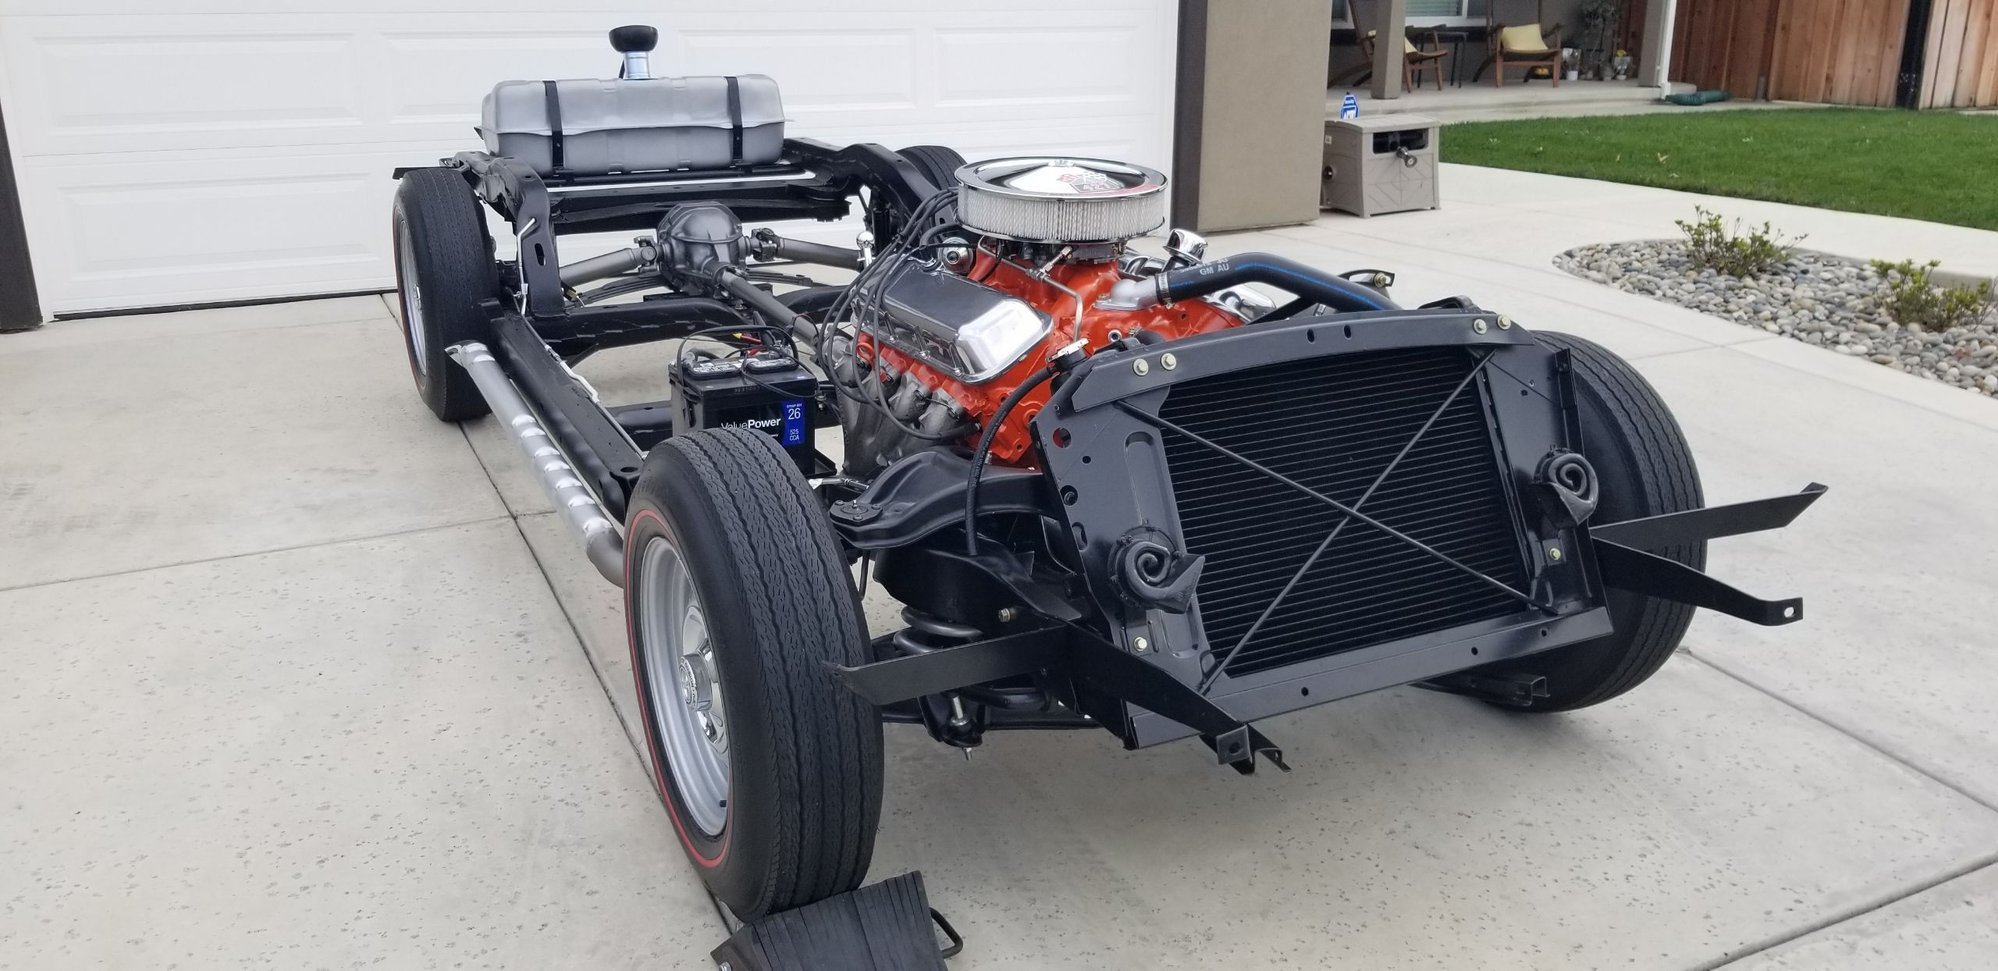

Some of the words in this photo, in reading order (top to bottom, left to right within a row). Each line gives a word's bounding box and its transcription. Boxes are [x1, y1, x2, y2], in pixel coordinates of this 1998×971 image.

[1199, 267, 1214, 276] GM
[1217, 263, 1230, 272] AU
[788, 407, 801, 420] 26
[721, 418, 782, 430] ValuePower
